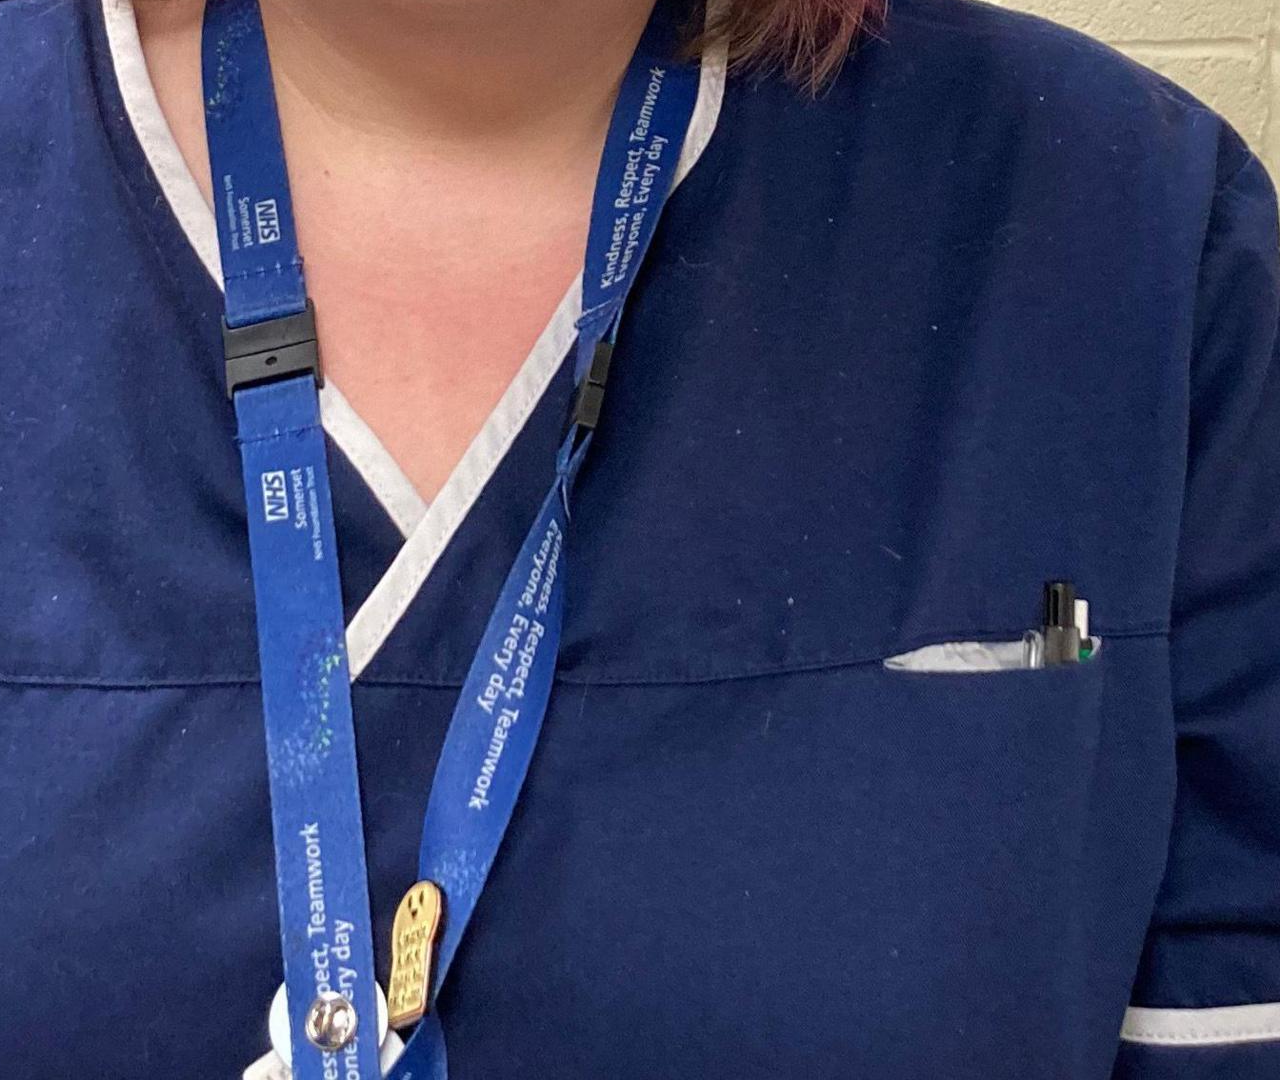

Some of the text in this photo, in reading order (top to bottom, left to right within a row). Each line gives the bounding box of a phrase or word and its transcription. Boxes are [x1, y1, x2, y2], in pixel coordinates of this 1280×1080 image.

[601, 66, 666, 289] Kindness, Respect, Teamwork
[615, 135, 668, 283] Everyone, Every day
[238, 196, 253, 247] Somerset
[256, 200, 279, 243] NHS
[263, 472, 288, 520] NHS
[290, 468, 308, 528] Somerset
[477, 518, 558, 715] Everyone, Every day
[505, 620, 544, 699] Respect,
[469, 709, 519, 811] Teamwork
[299, 822, 326, 938] Teamwork
[332, 919, 354, 960] day
